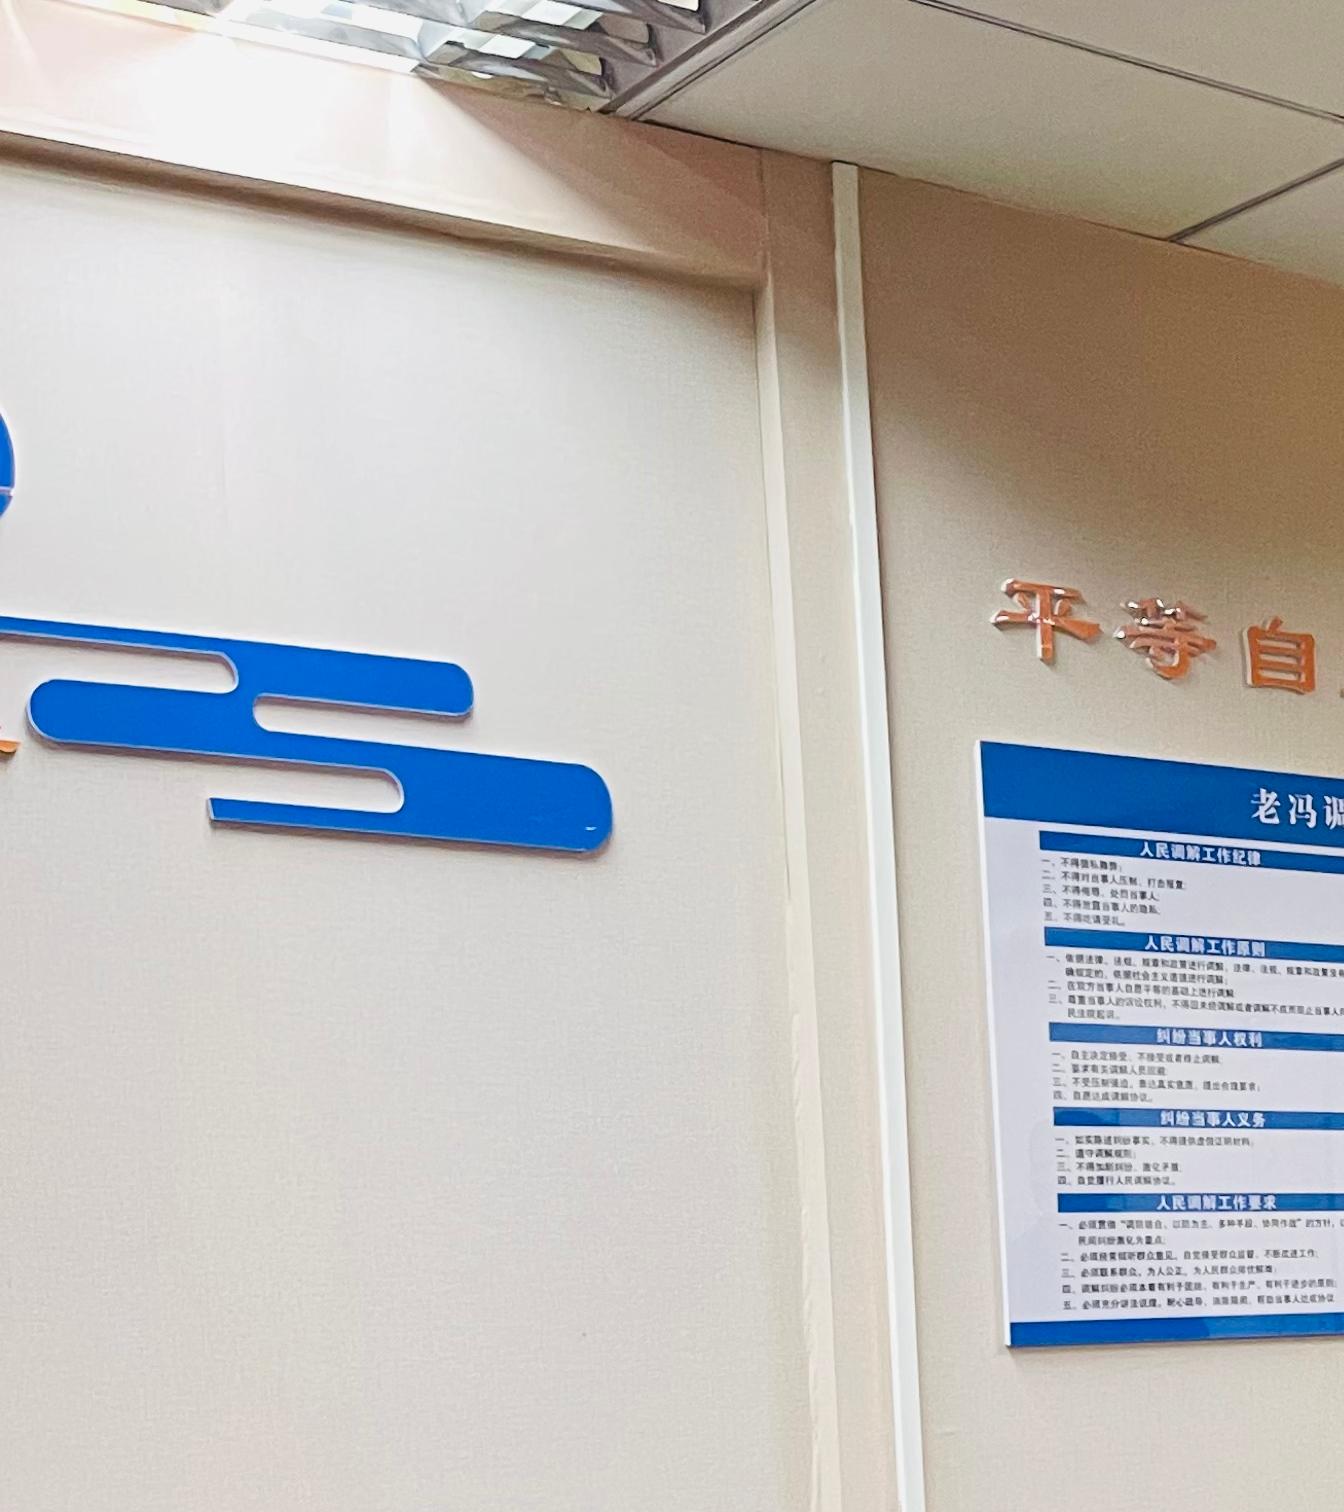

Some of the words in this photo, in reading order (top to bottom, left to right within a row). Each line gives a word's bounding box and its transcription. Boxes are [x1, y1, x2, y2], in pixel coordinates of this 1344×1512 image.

[1140, 841, 1261, 866] 人民调解工作纪律
[1145, 935, 1266, 957] 人民调解工作原则
[1157, 1028, 1262, 1047] 纠纷当事人权利
[1160, 1111, 1266, 1129] 纠纷当事人义务
[1156, 1195, 1278, 1211] 人民调解工作要求
